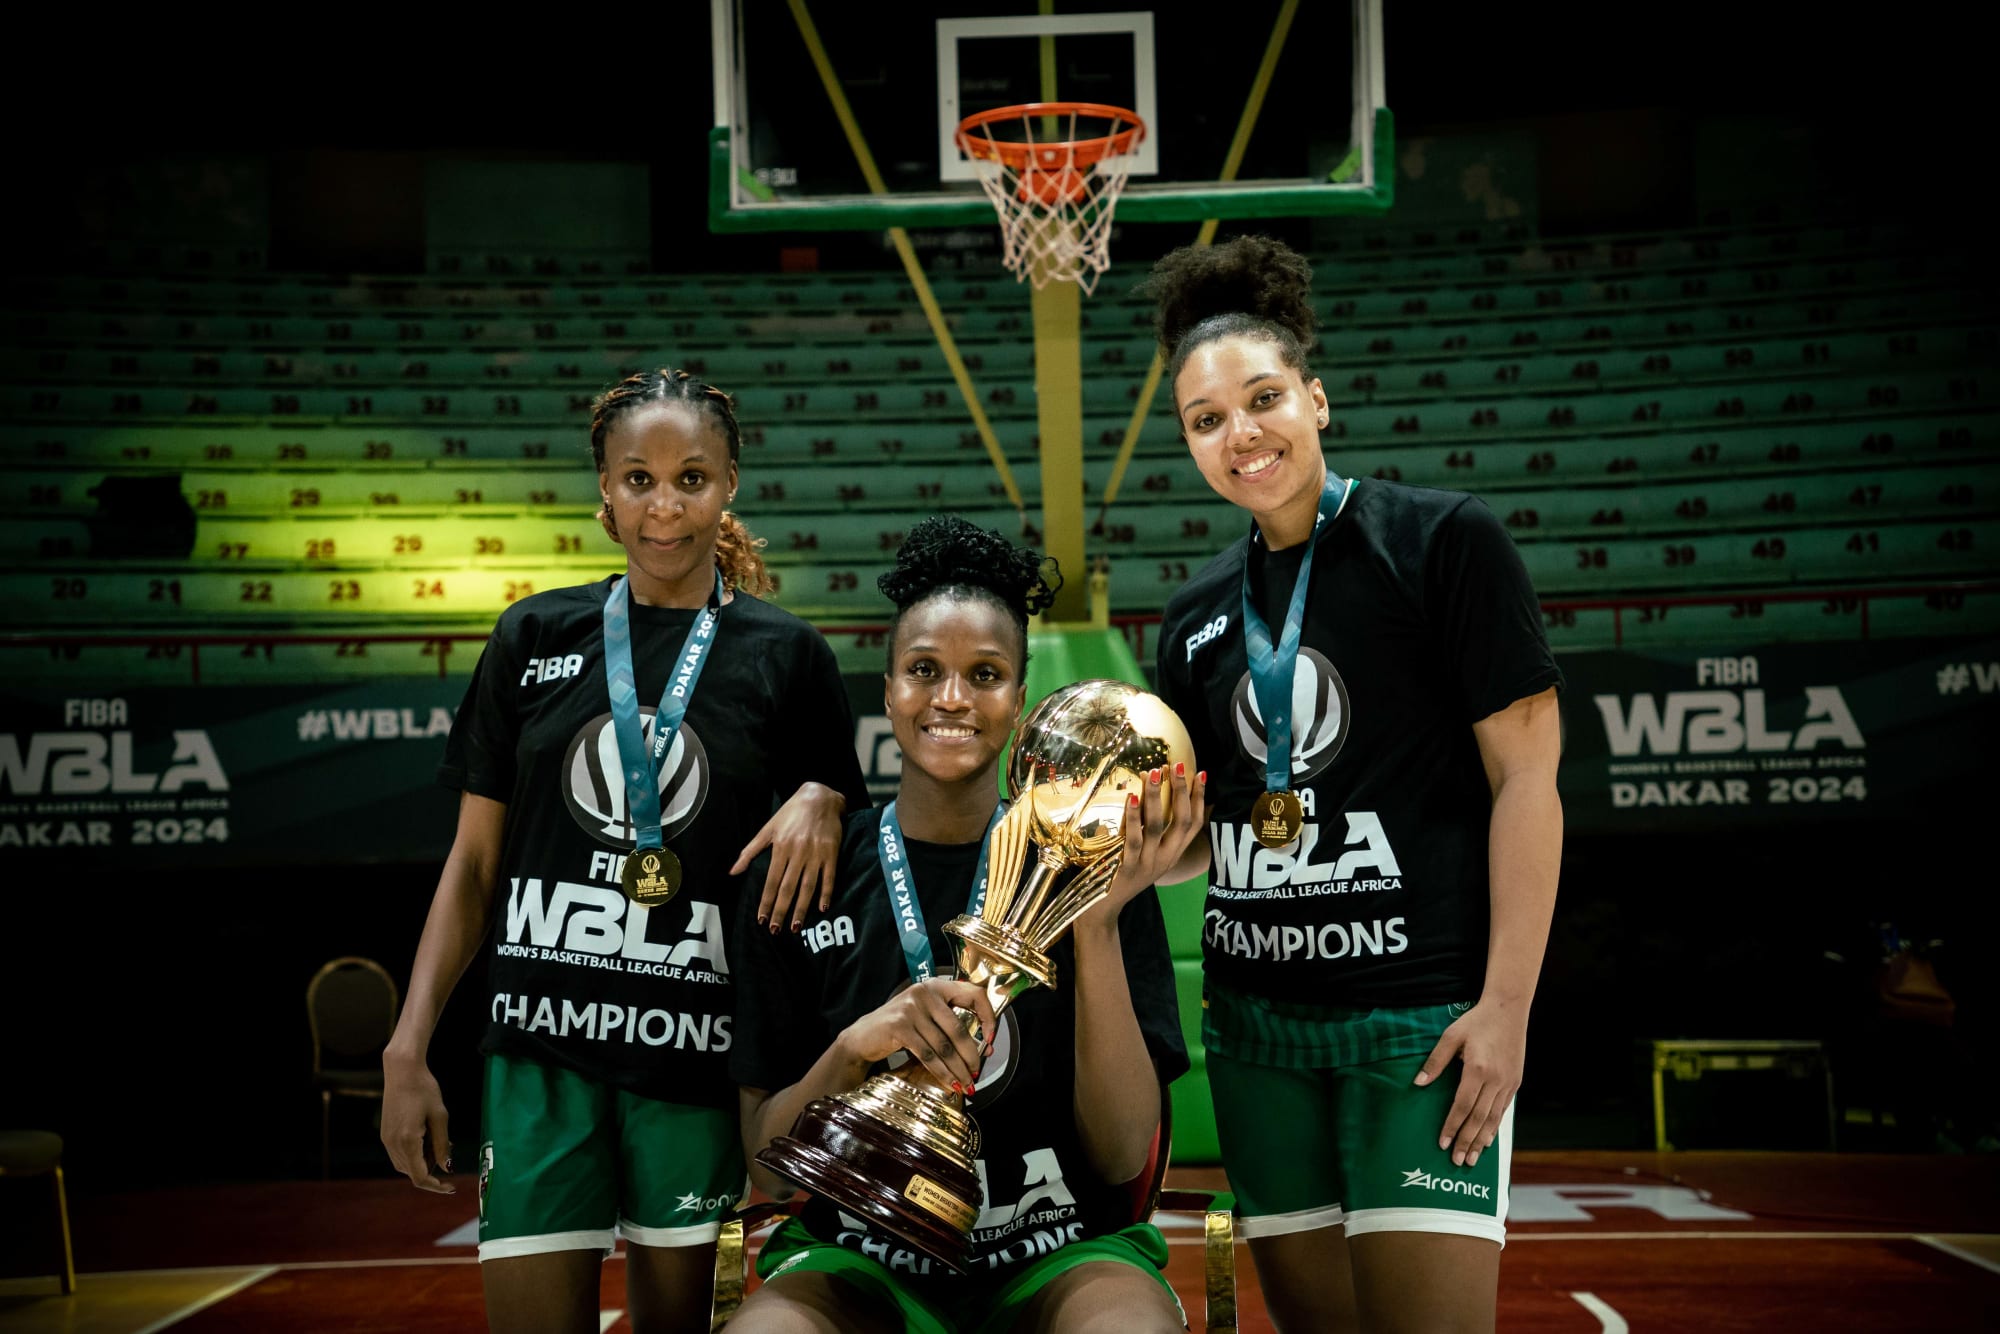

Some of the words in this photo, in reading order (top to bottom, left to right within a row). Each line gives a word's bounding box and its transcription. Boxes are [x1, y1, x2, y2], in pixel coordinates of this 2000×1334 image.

[1633, 403, 1660, 420] 47
[1690, 444, 1719, 463] 47
[1850, 486, 1882, 505] 47
[1591, 508, 1623, 524] 44
[218, 542, 248, 559] 27
[475, 536, 504, 555] 30
[553, 534, 582, 554] 31
[1847, 531, 1878, 553] 41
[53, 579, 86, 599] 20
[149, 580, 182, 604] 21
[241, 582, 271, 601] 22
[329, 580, 361, 600] 23
[413, 580, 445, 599] 24
[672, 643, 704, 698] DAKAR
[696, 606, 719, 639] 2024
[520, 653, 585, 687] FIBA
[1696, 655, 1759, 686] FIBA
[64, 697, 128, 727] FIBA
[297, 706, 459, 741] #WBLA
[1593, 685, 1867, 756] WBLA
[654, 726, 673, 758] WBLA
[1610, 779, 1750, 808] DAKAR
[1767, 776, 1867, 803] 2024
[0, 820, 112, 847] AKAR
[130, 817, 230, 845] 2024
[880, 825, 900, 863] 2024
[1210, 811, 1403, 889] WBLA
[891, 867, 918, 932] DAKAR
[1298, 881, 1348, 897] LEAGUE
[1351, 877, 1402, 893] AFRICA
[506, 877, 730, 975] WBLA
[1204, 908, 1409, 962] CHAMPIONS
[497, 944, 539, 960] WOMEN'S
[540, 949, 624, 972] BASKETBALL
[626, 960, 682, 980] LEAGUE
[684, 969, 731, 985] AFRICA
[491, 992, 733, 1053] CHAMPIONS
[979, 1217, 1025, 1241] LEAGUE
[1027, 1207, 1077, 1225] AFRICA
